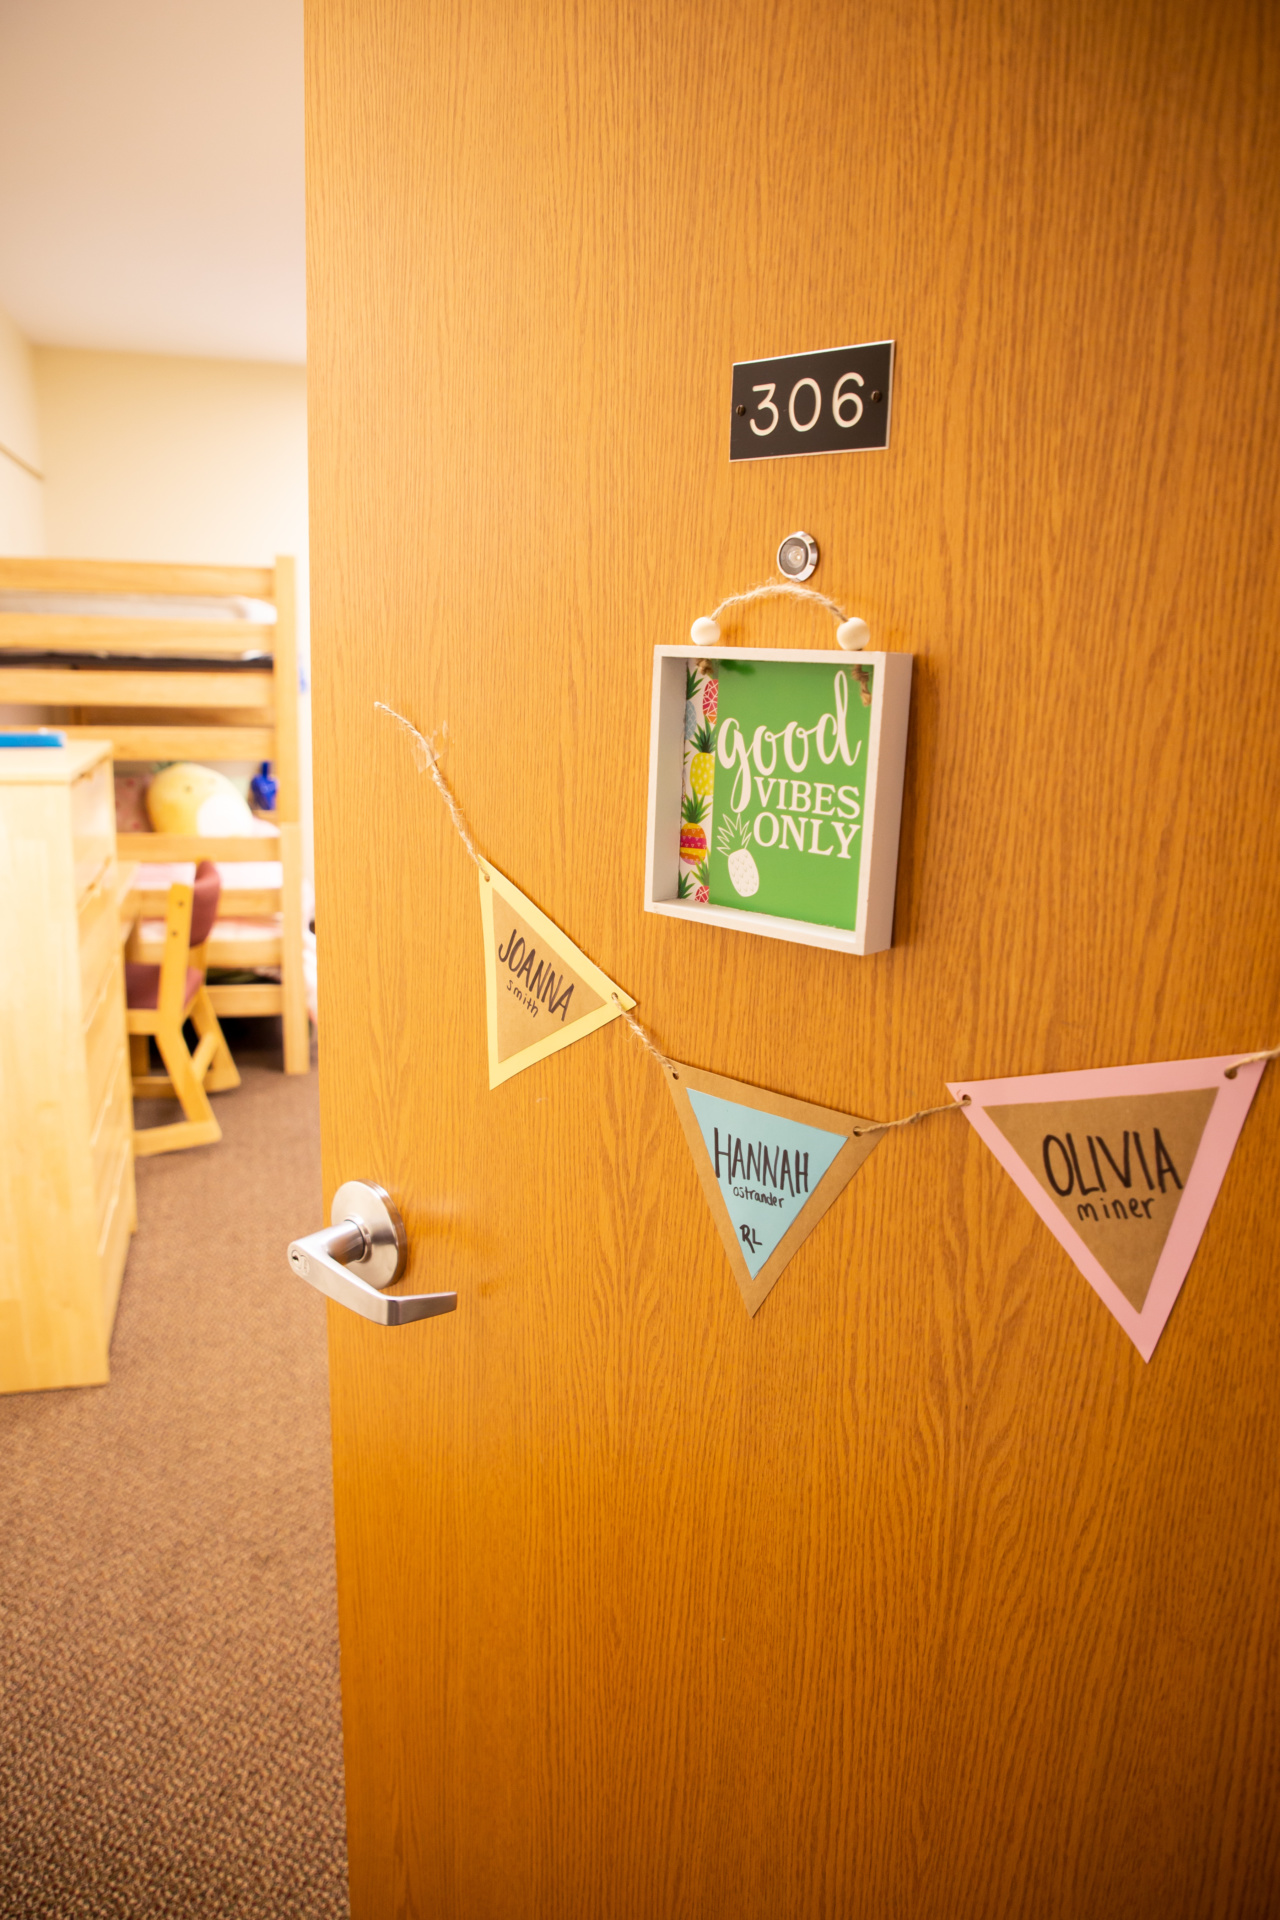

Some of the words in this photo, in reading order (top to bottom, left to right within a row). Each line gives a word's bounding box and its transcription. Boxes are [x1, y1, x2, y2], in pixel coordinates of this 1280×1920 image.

[750, 372, 864, 436] 306
[718, 670, 862, 813] good
[754, 776, 861, 819] VIBES
[753, 812, 861, 859] ONLY
[498, 929, 575, 1022] JOANNA
[506, 979, 539, 1018] smith
[713, 1127, 809, 1197] HANNAH
[1042, 1127, 1184, 1197] OLIVIA
[733, 1186, 784, 1208] ostrander
[1077, 1198, 1155, 1222] miner
[739, 1224, 763, 1254] RL
